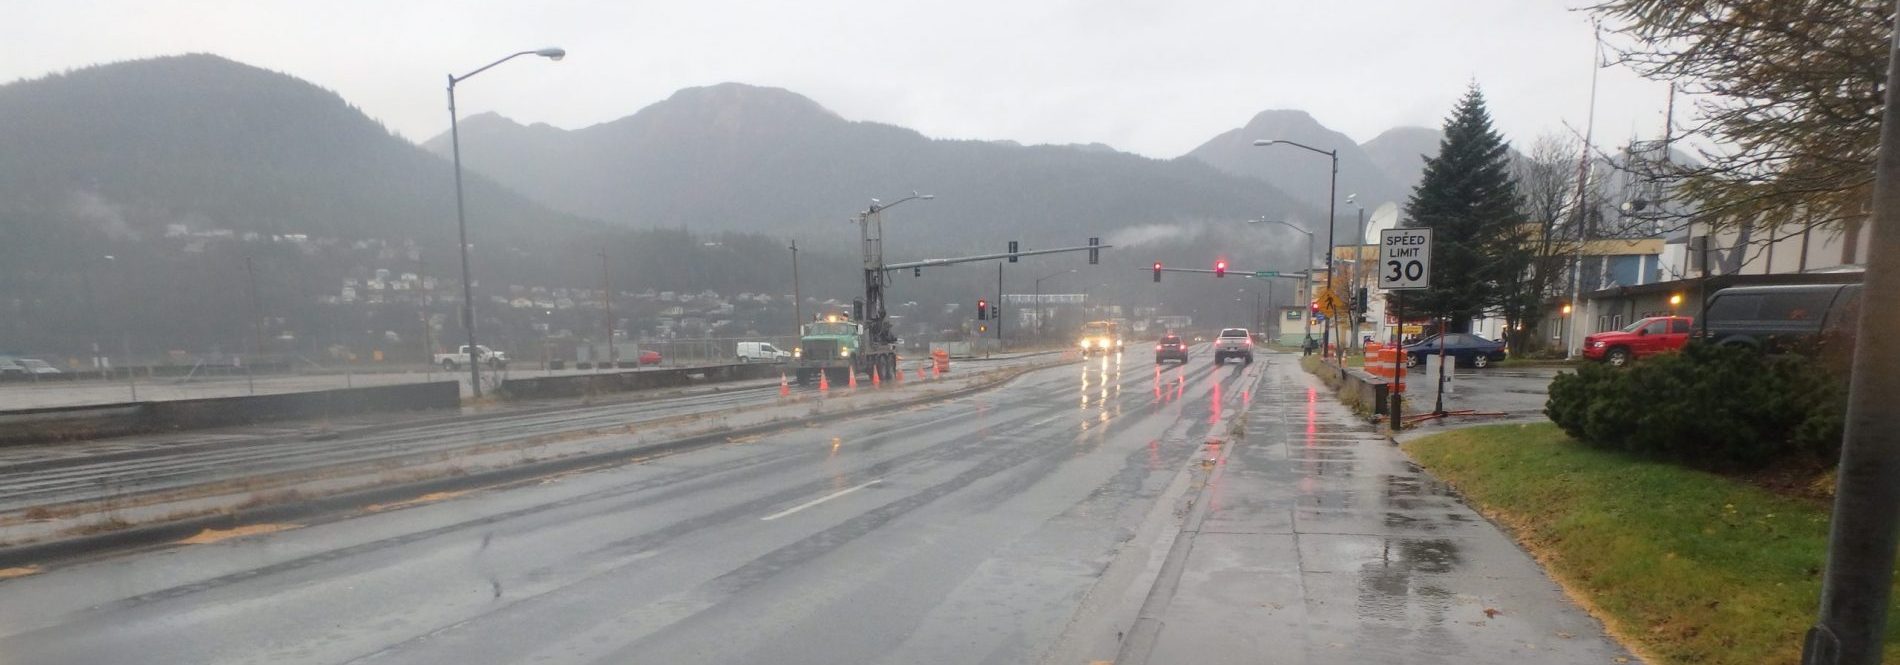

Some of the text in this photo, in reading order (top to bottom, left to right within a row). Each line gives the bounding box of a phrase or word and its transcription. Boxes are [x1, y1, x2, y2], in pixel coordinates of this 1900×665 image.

[1386, 235, 1425, 245] SPEED
[1389, 248, 1420, 257] LIMIT
[1385, 260, 1423, 281] 30
